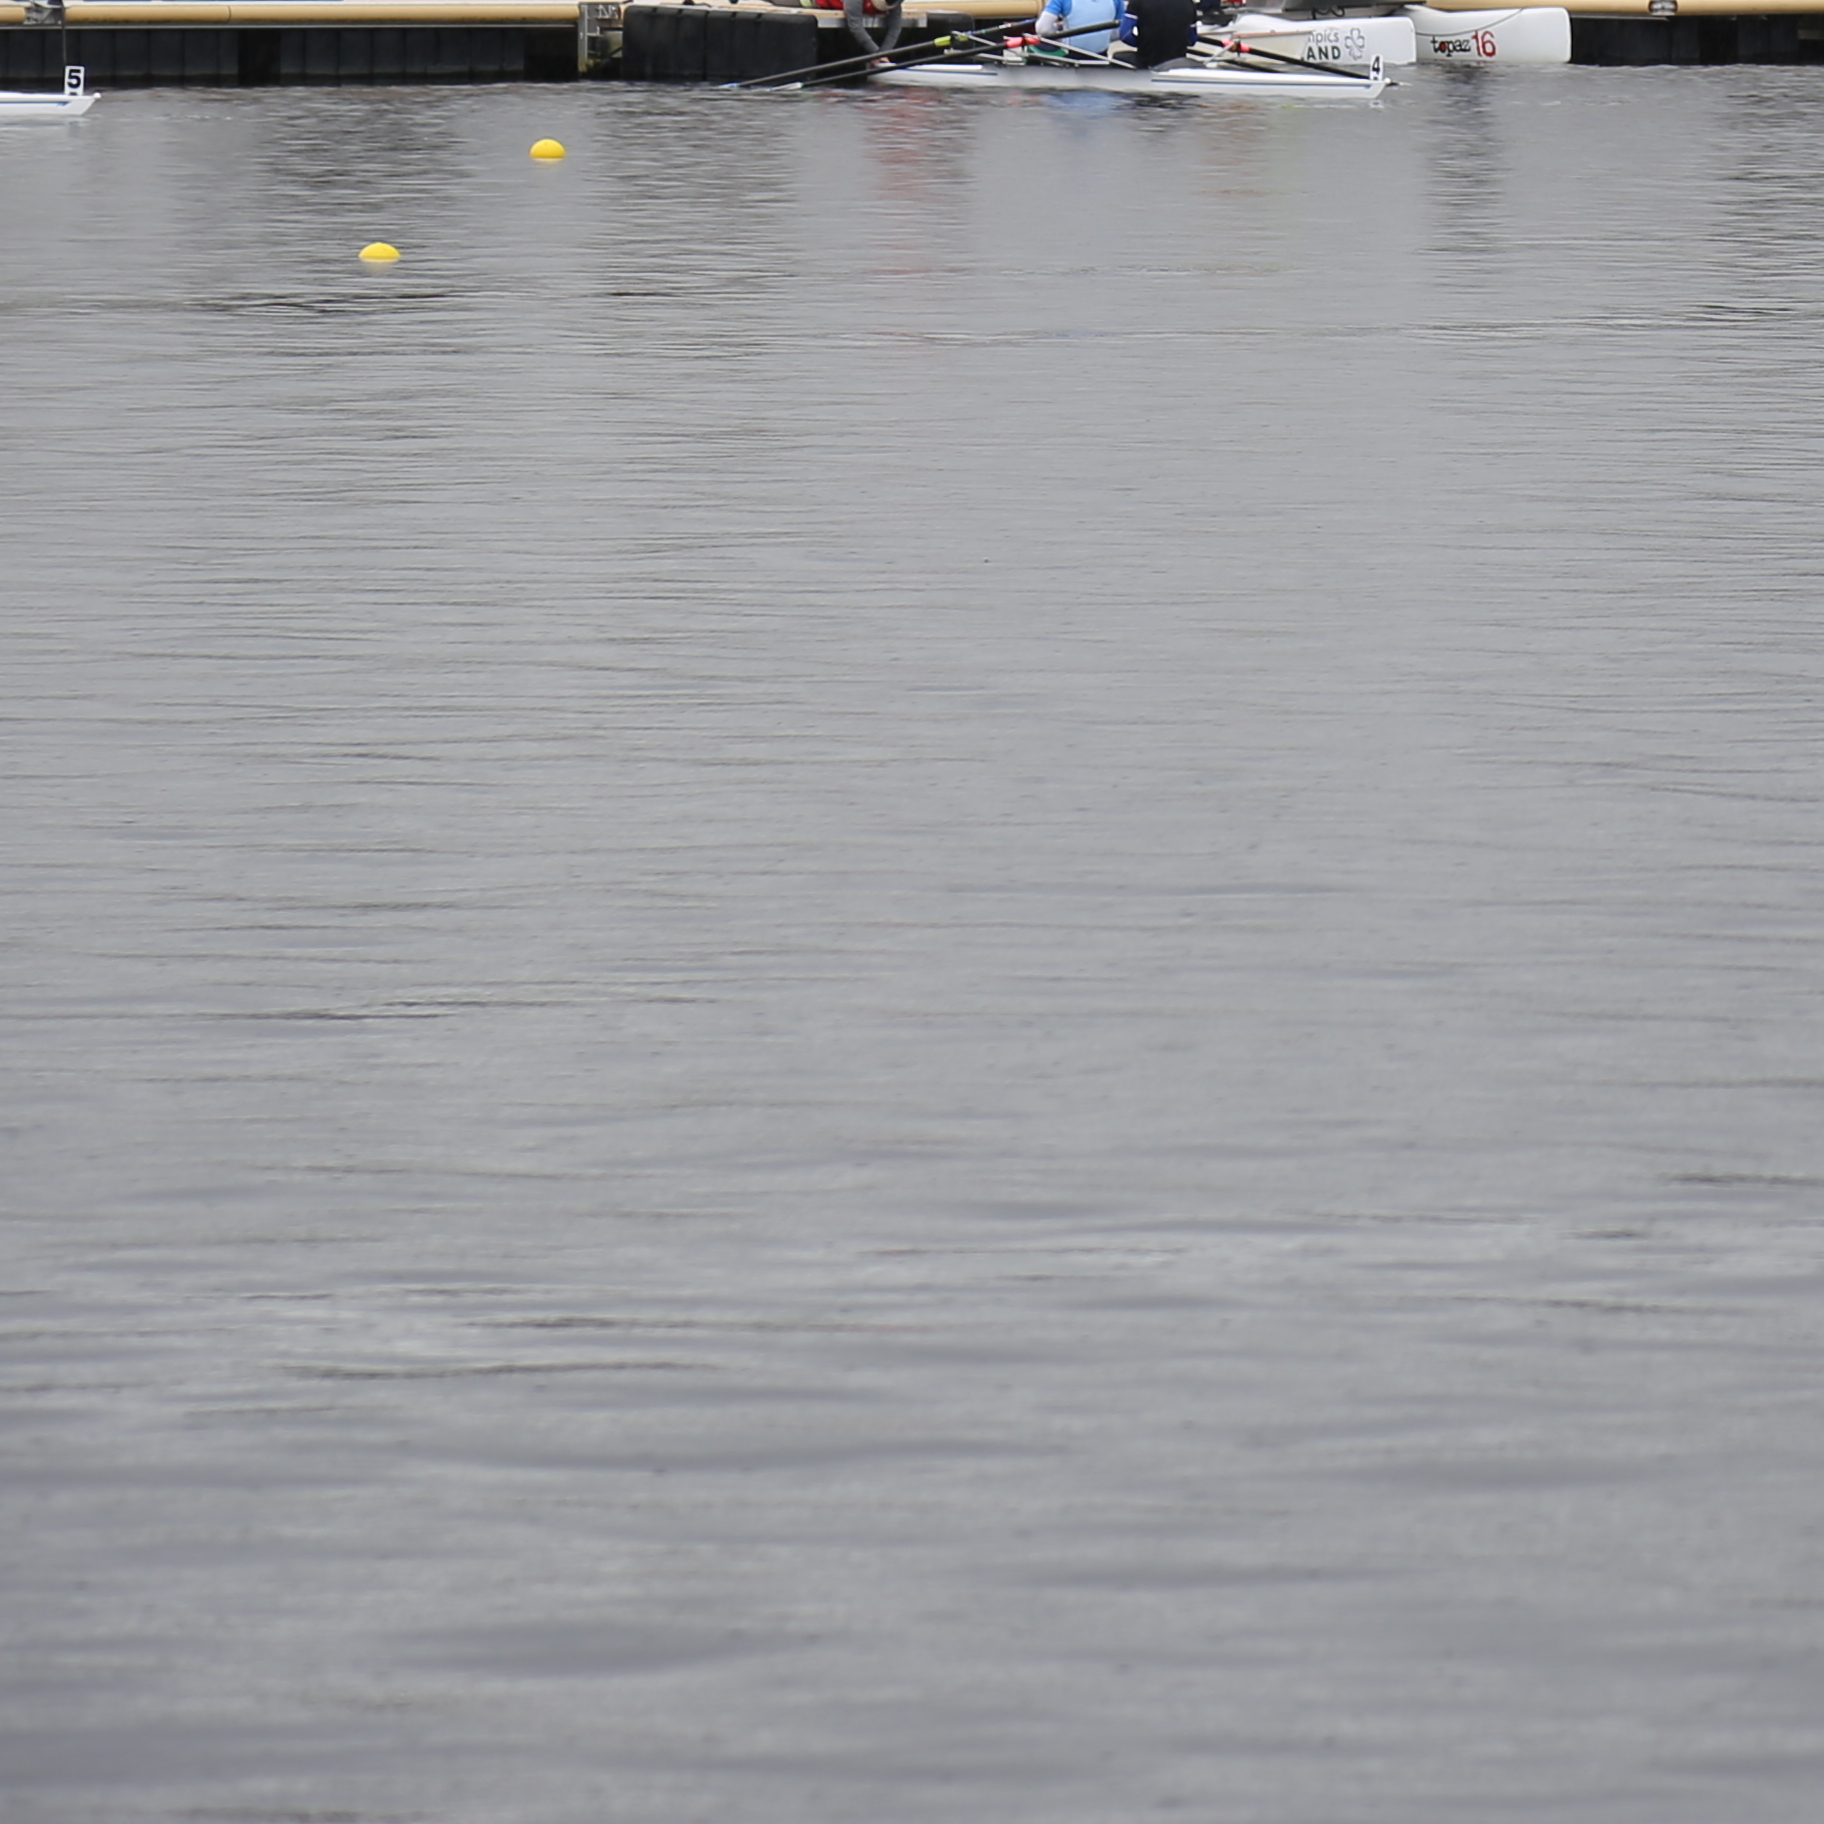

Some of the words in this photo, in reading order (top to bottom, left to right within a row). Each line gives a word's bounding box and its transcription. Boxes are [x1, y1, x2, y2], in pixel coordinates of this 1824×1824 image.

[1306, 46, 1341, 60] AND
[1431, 35, 1471, 57] topaz
[1473, 31, 1497, 57] 16
[1372, 57, 1380, 74] 4
[67, 69, 81, 89] 5
